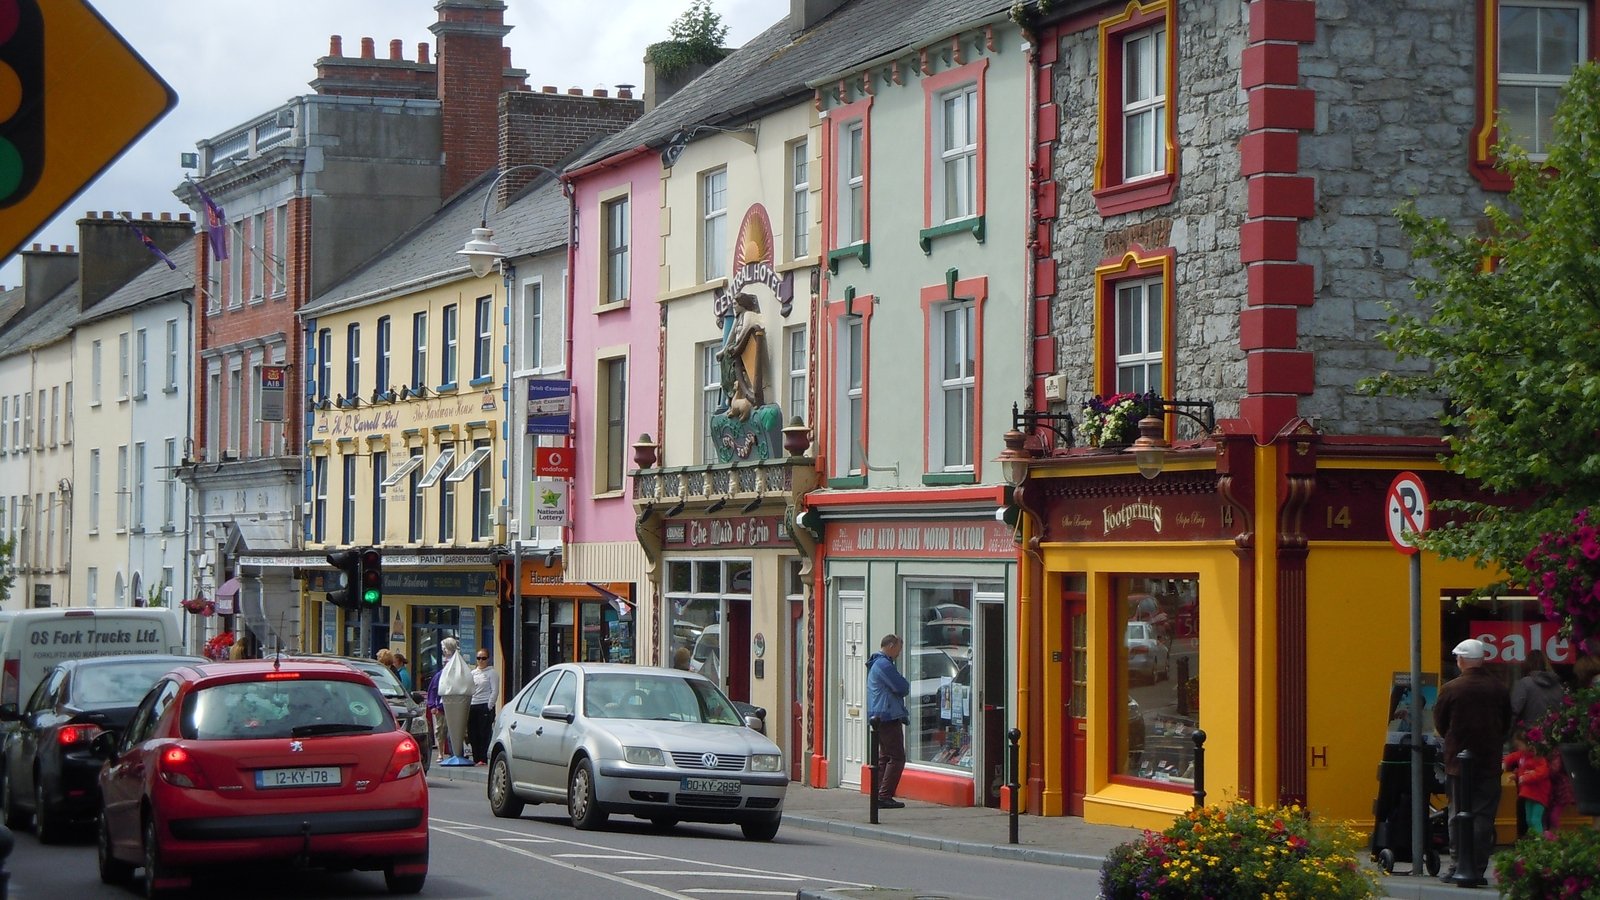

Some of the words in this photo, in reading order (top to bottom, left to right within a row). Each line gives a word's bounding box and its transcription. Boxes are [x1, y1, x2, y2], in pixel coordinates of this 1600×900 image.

[714, 265, 752, 316] CENTRAL
[753, 264, 783, 301] HOTEL
[1103, 497, 1162, 536] Footprints
[1220, 505, 1233, 528] 14
[1327, 506, 1352, 529] 14
[666, 530, 685, 538] LOUNGE
[690, 518, 707, 546] The
[710, 518, 733, 545] Maid
[736, 521, 745, 542] of
[749, 517, 769, 546] Erin
[857, 528, 875, 550] AGRI
[878, 528, 896, 550] AUTO
[899, 528, 920, 550] PARTS
[924, 527, 950, 550] MOTOR
[952, 527, 985, 550] FACTORS
[30, 631, 49, 645] OS
[53, 630, 82, 645] Fork
[87, 629, 131, 644] Trucks
[136, 629, 160, 643] Ltd.
[1475, 623, 1569, 663] sale
[68, 651, 80, 659] AND
[1312, 746, 1326, 767] H
[276, 771, 328, 785] 12-KY-178
